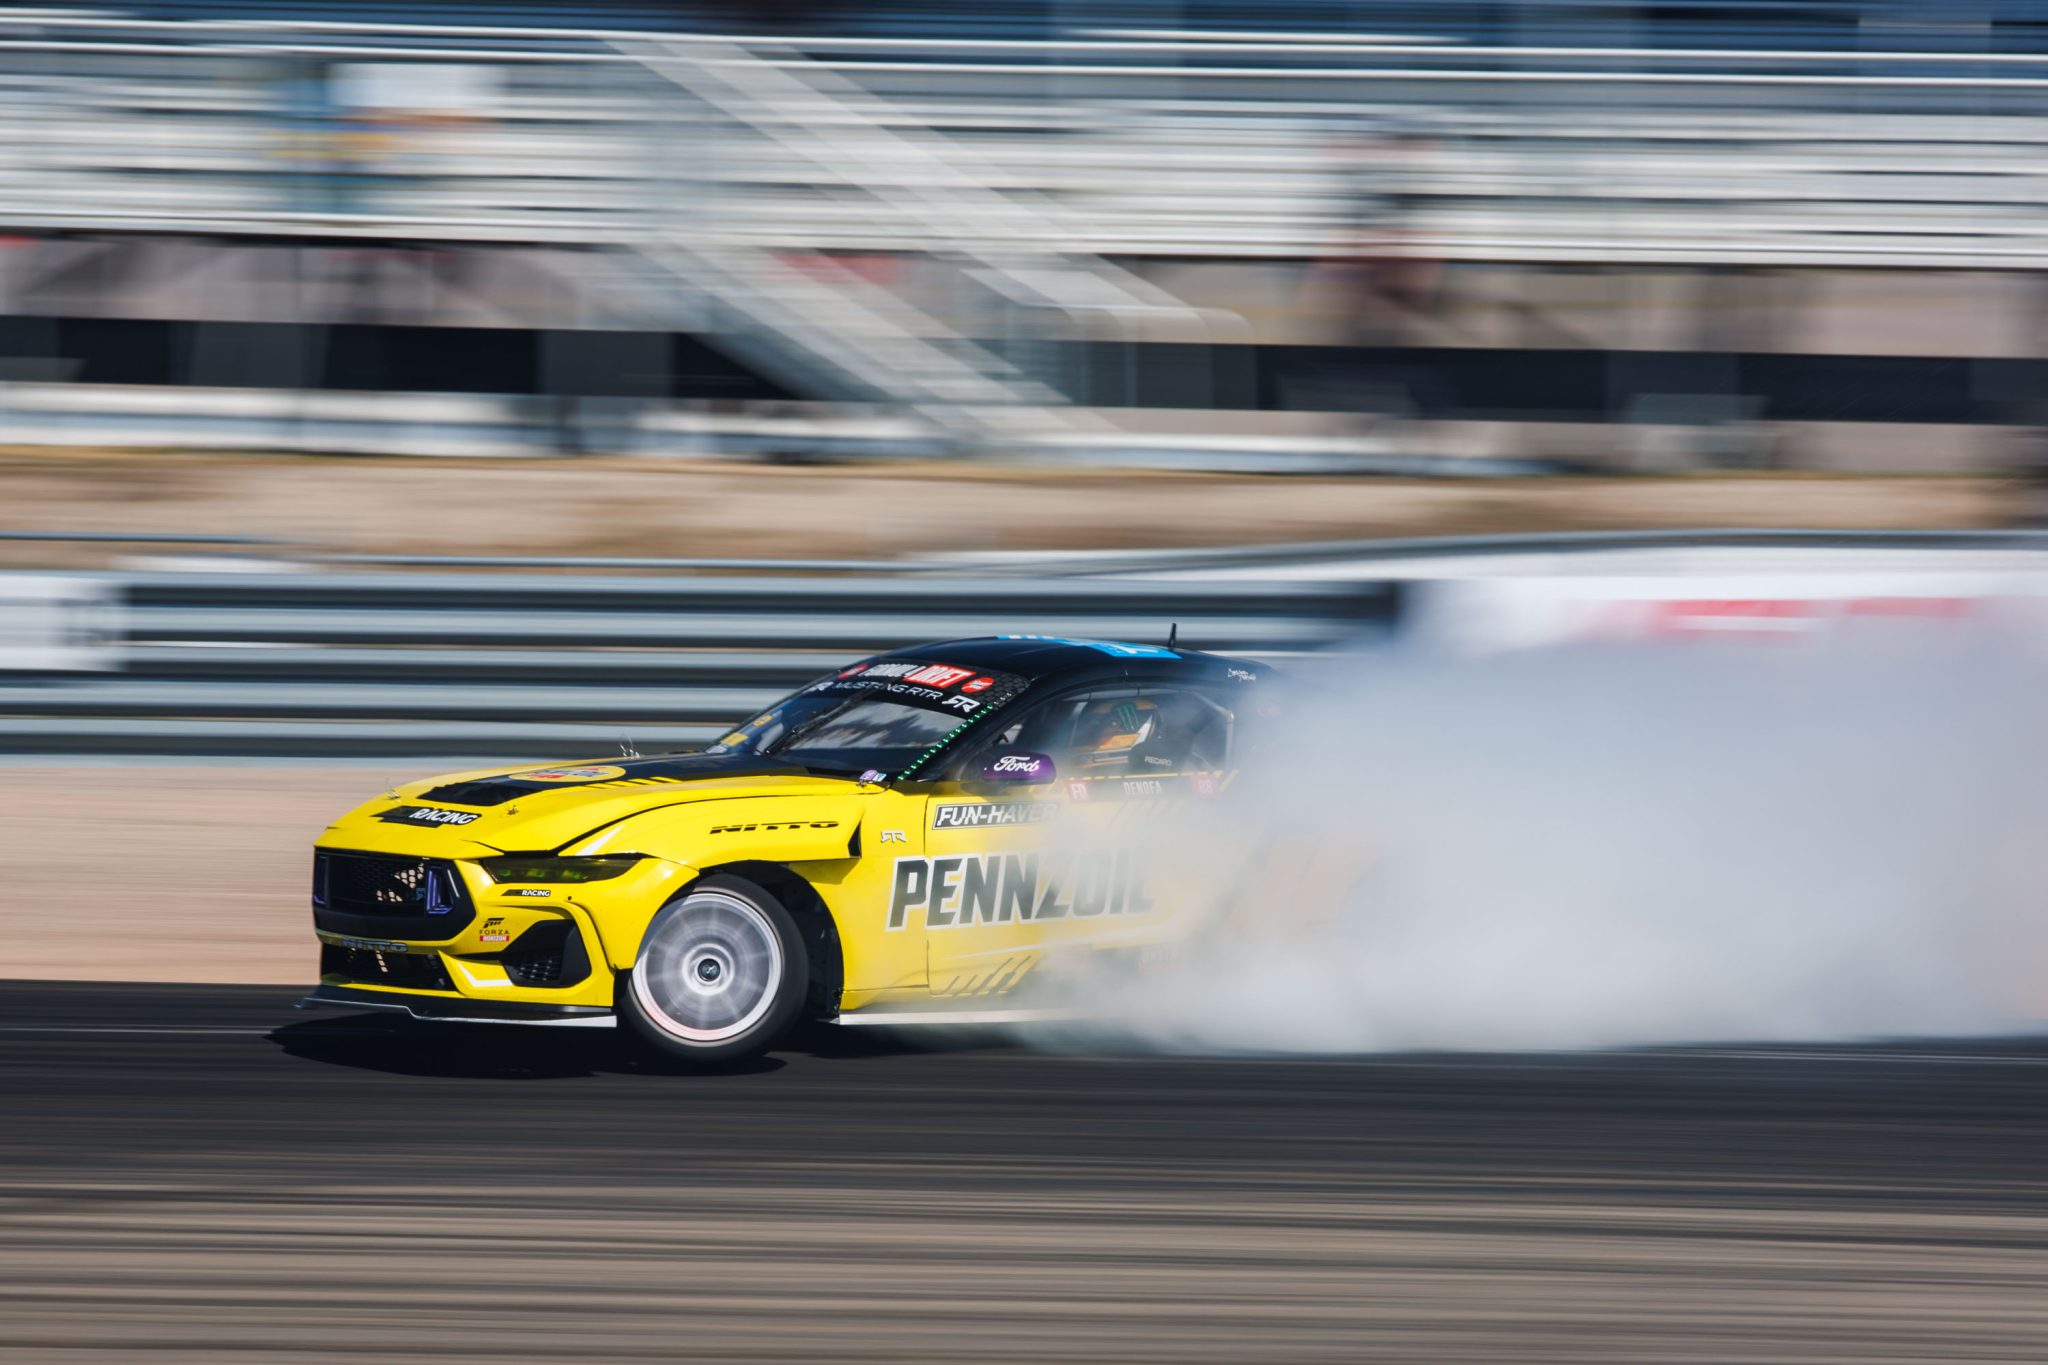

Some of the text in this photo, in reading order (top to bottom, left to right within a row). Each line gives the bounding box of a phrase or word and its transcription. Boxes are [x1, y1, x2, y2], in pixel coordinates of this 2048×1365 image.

[833, 681, 907, 694] MUSTNG
[993, 755, 1040, 772] Ford
[1123, 781, 1162, 795] DENOFA
[409, 808, 478, 824] RACING
[709, 820, 839, 834] NITTO
[887, 853, 1155, 931] PENNZOIL
